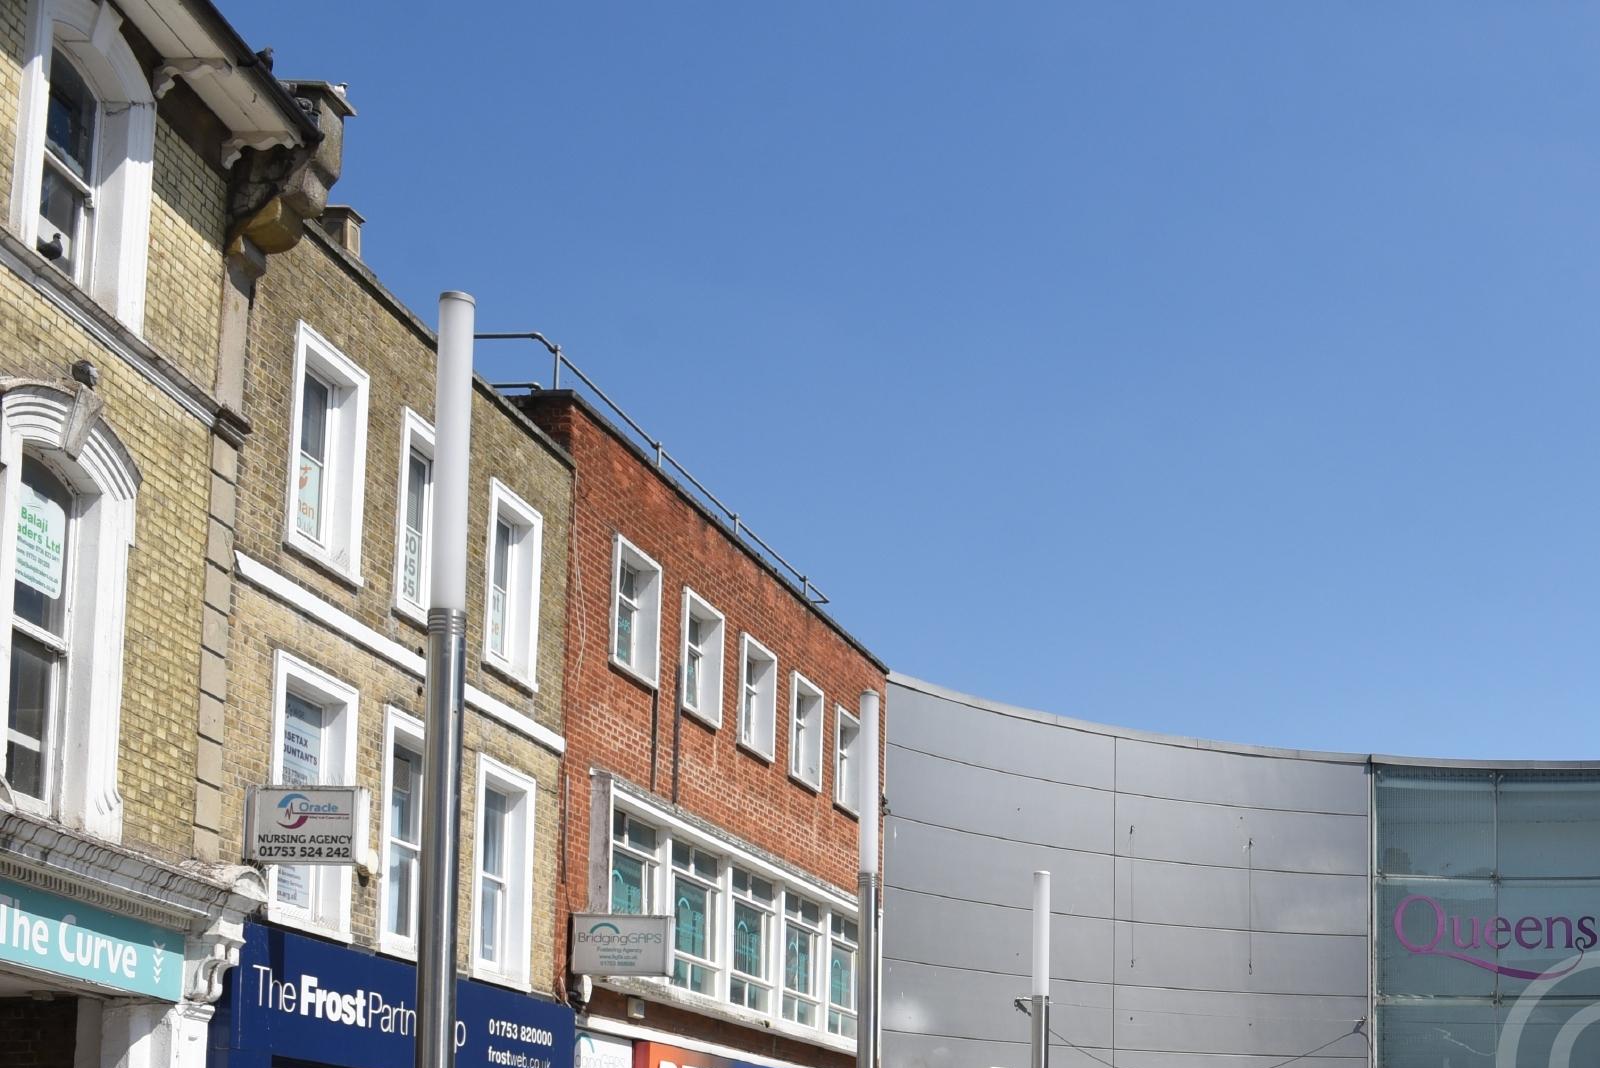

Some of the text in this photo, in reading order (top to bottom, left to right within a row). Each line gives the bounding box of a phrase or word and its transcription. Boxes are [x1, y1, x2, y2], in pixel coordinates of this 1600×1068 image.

[21, 506, 48, 533] Balaji
[17, 522, 43, 544] aders
[46, 536, 61, 553] Ltd
[283, 743, 318, 766] OUNTANTS
[299, 801, 339, 813] Oracle
[258, 834, 352, 845] NURSING AGENCY
[260, 846, 350, 858] 01753 524 242
[0, 894, 138, 979] The Curve
[578, 931, 662, 946] BridgingGAPS
[252, 964, 467, 1053] The Frost Partnp
[489, 1017, 553, 1047] 01753 820000
